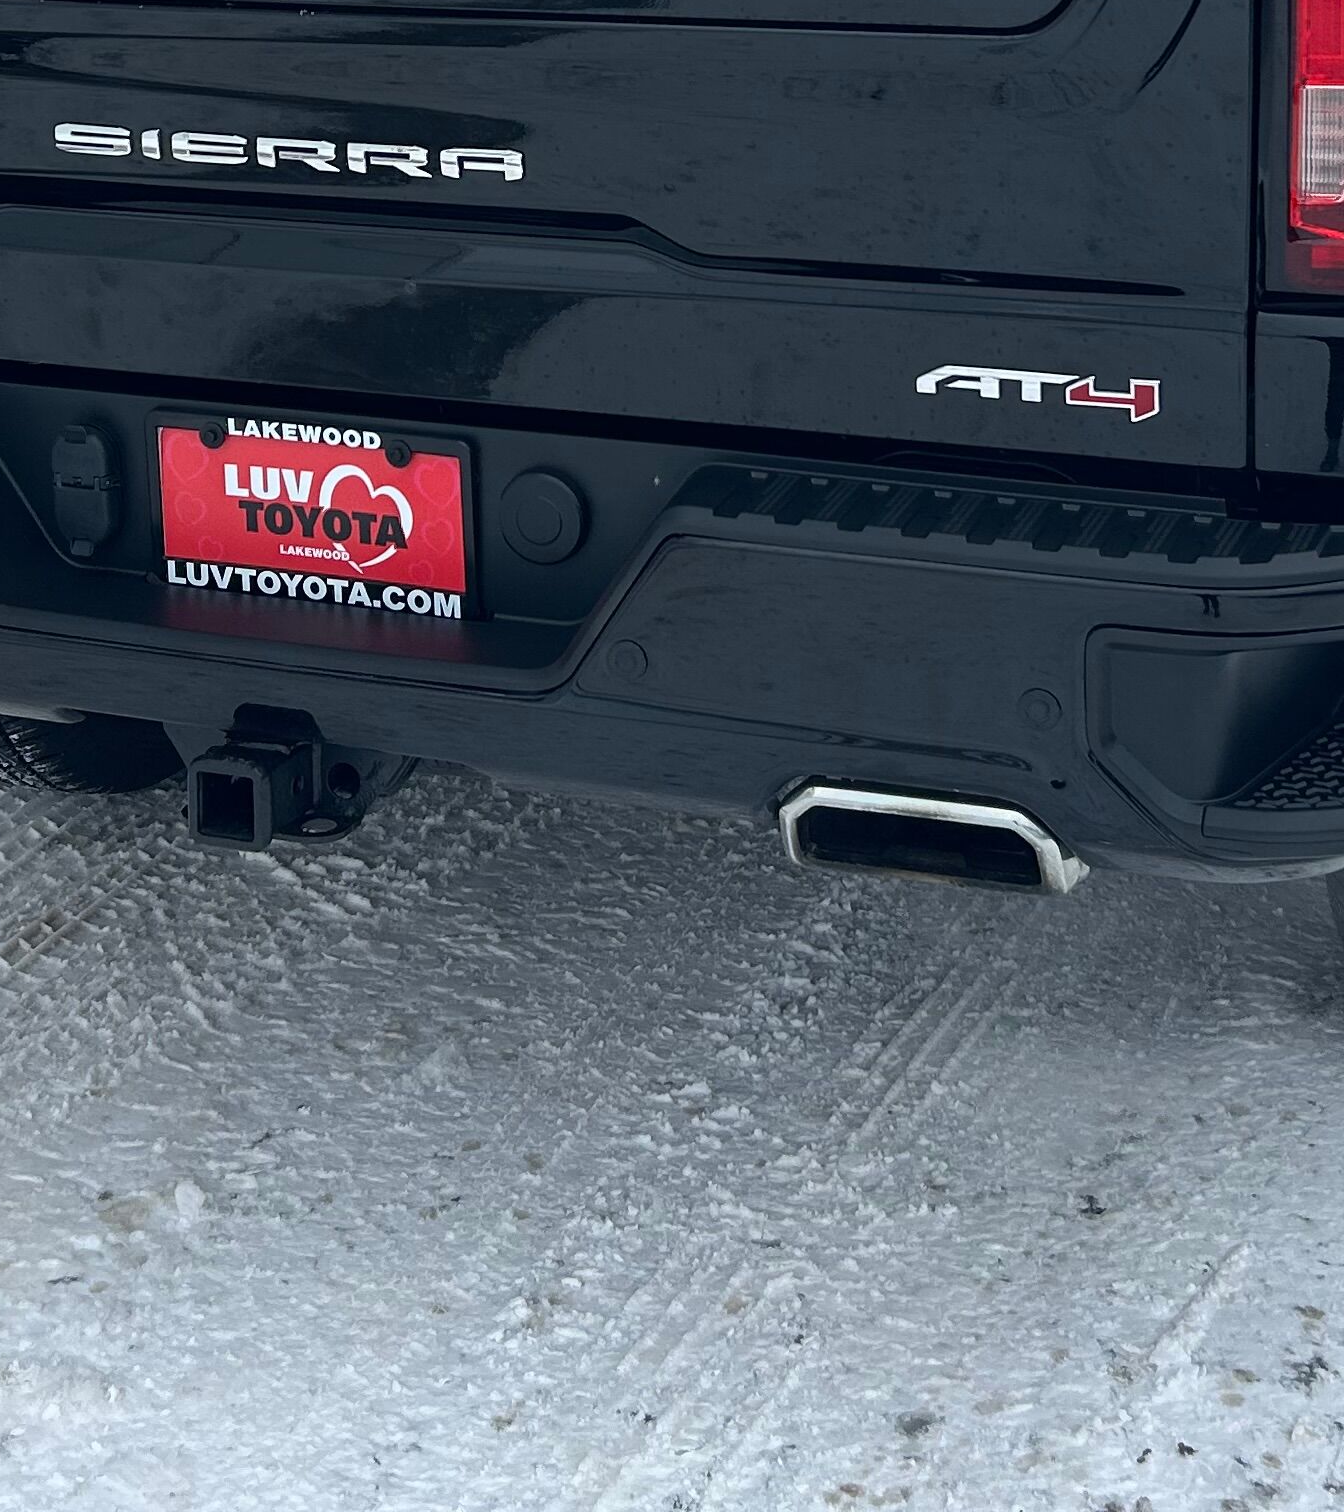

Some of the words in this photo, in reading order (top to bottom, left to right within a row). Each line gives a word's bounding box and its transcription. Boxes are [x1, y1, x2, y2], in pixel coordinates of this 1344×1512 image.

[53, 122, 526, 182] SIERRA
[916, 365, 1160, 423] AT4
[226, 417, 382, 449] LAKEWOOD
[223, 463, 314, 504] LUV
[238, 500, 408, 549] TOYOTA
[279, 544, 350, 561] LAKEWOOD
[166, 559, 462, 619] LUVTOYOTA.COM
